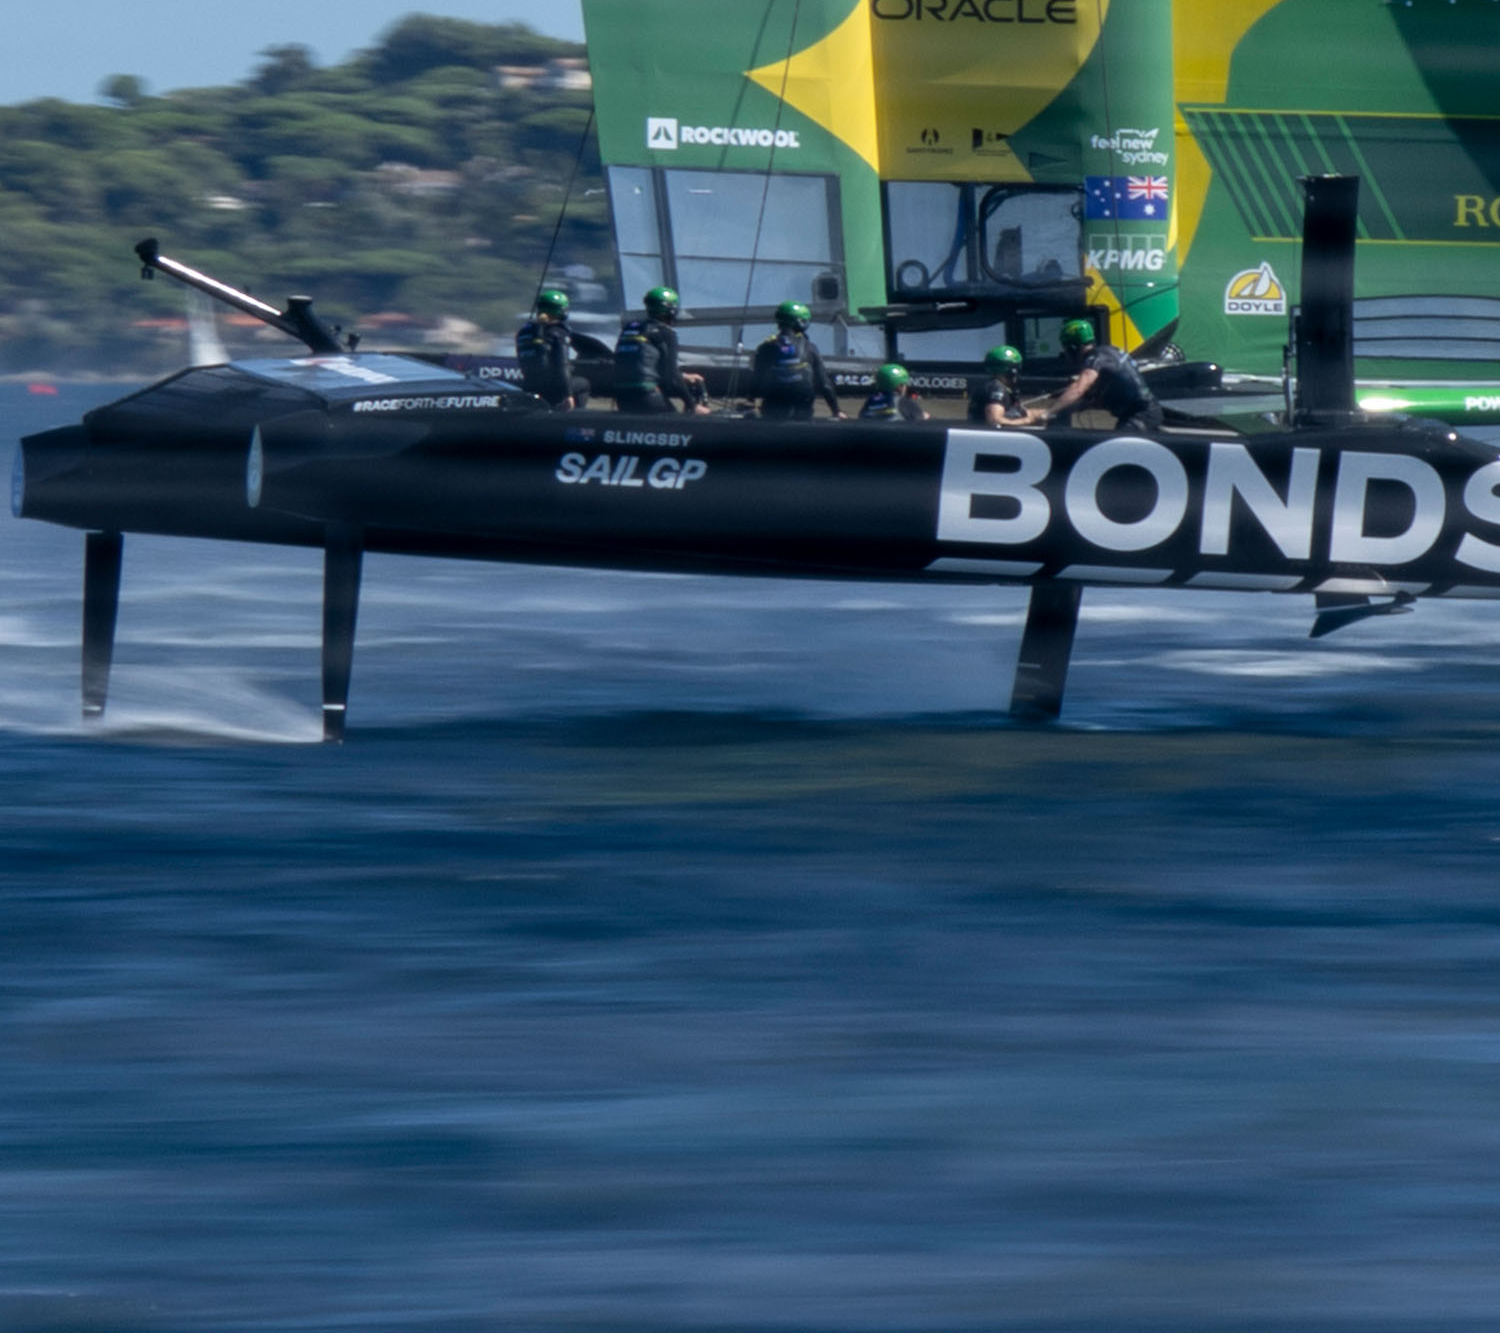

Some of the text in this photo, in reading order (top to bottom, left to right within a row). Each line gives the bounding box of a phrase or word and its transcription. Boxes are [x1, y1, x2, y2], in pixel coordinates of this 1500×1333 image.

[681, 124, 800, 148] ROCKWOOL
[1122, 137, 1155, 150] new
[1085, 247, 1167, 271] KPMG
[1227, 299, 1284, 313] DOYLE
[603, 429, 693, 447] SLINGSBY
